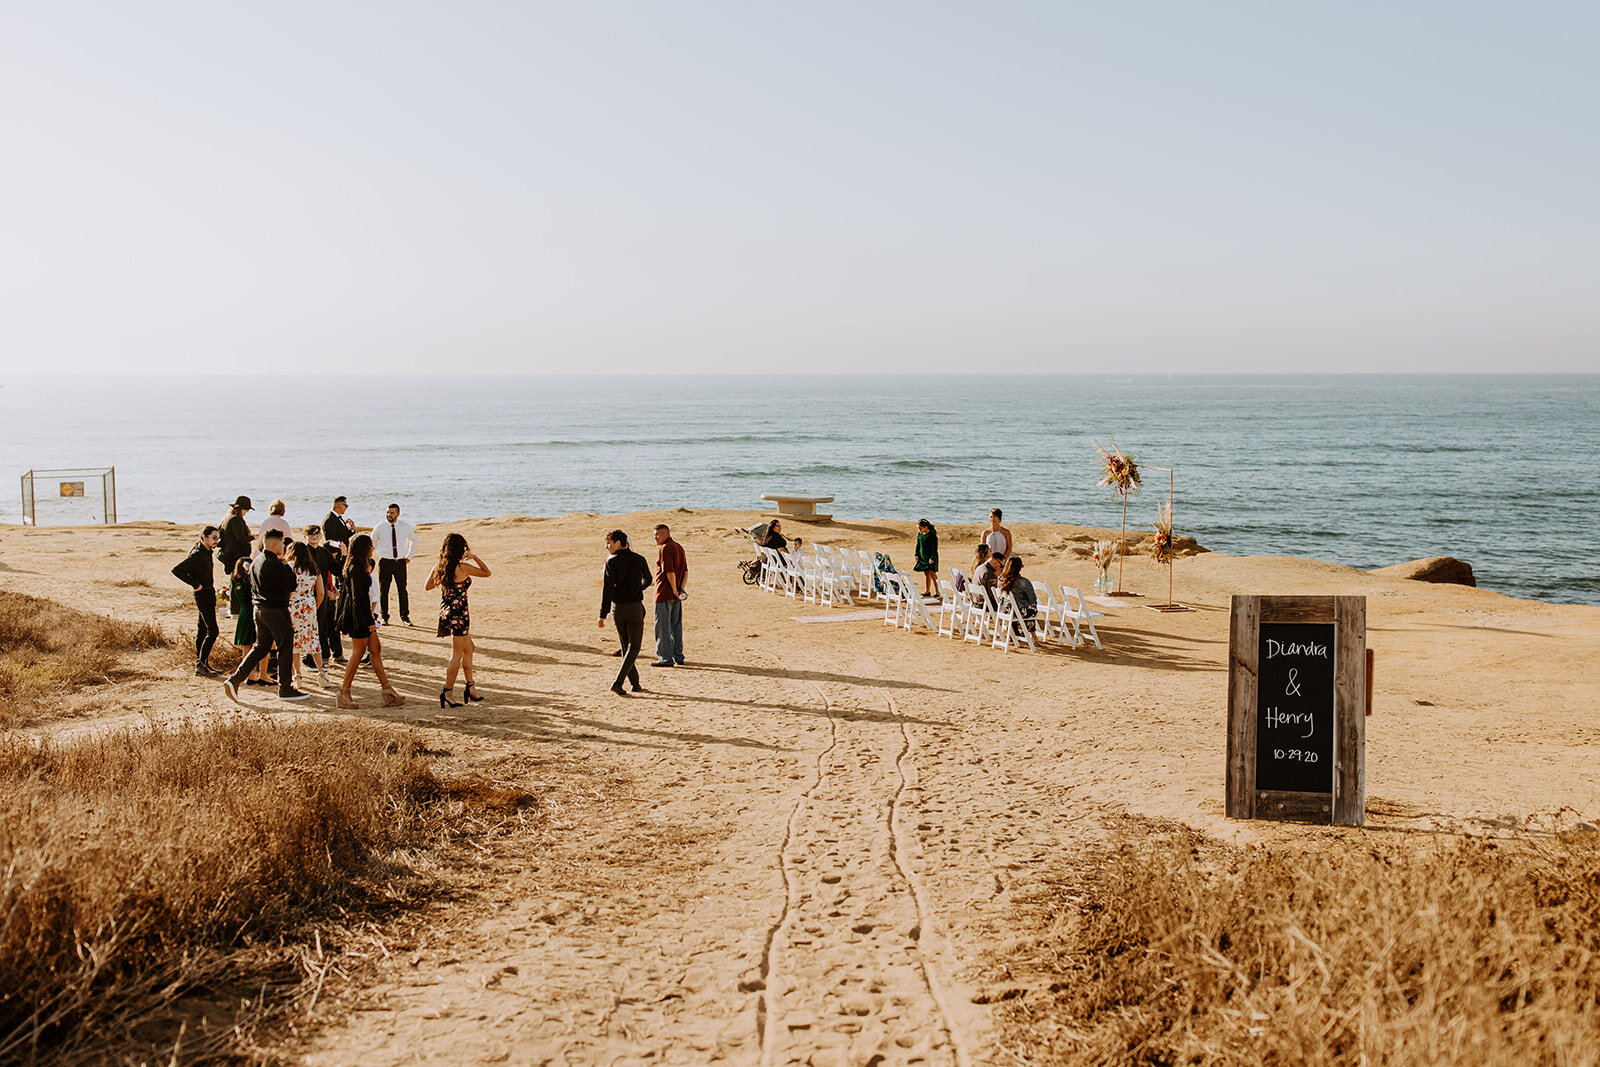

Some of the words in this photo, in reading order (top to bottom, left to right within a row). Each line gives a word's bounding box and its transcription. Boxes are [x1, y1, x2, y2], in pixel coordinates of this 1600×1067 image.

[1265, 638, 1328, 660] Diandra
[1285, 667, 1302, 697] &
[1265, 706, 1314, 739] Henry
